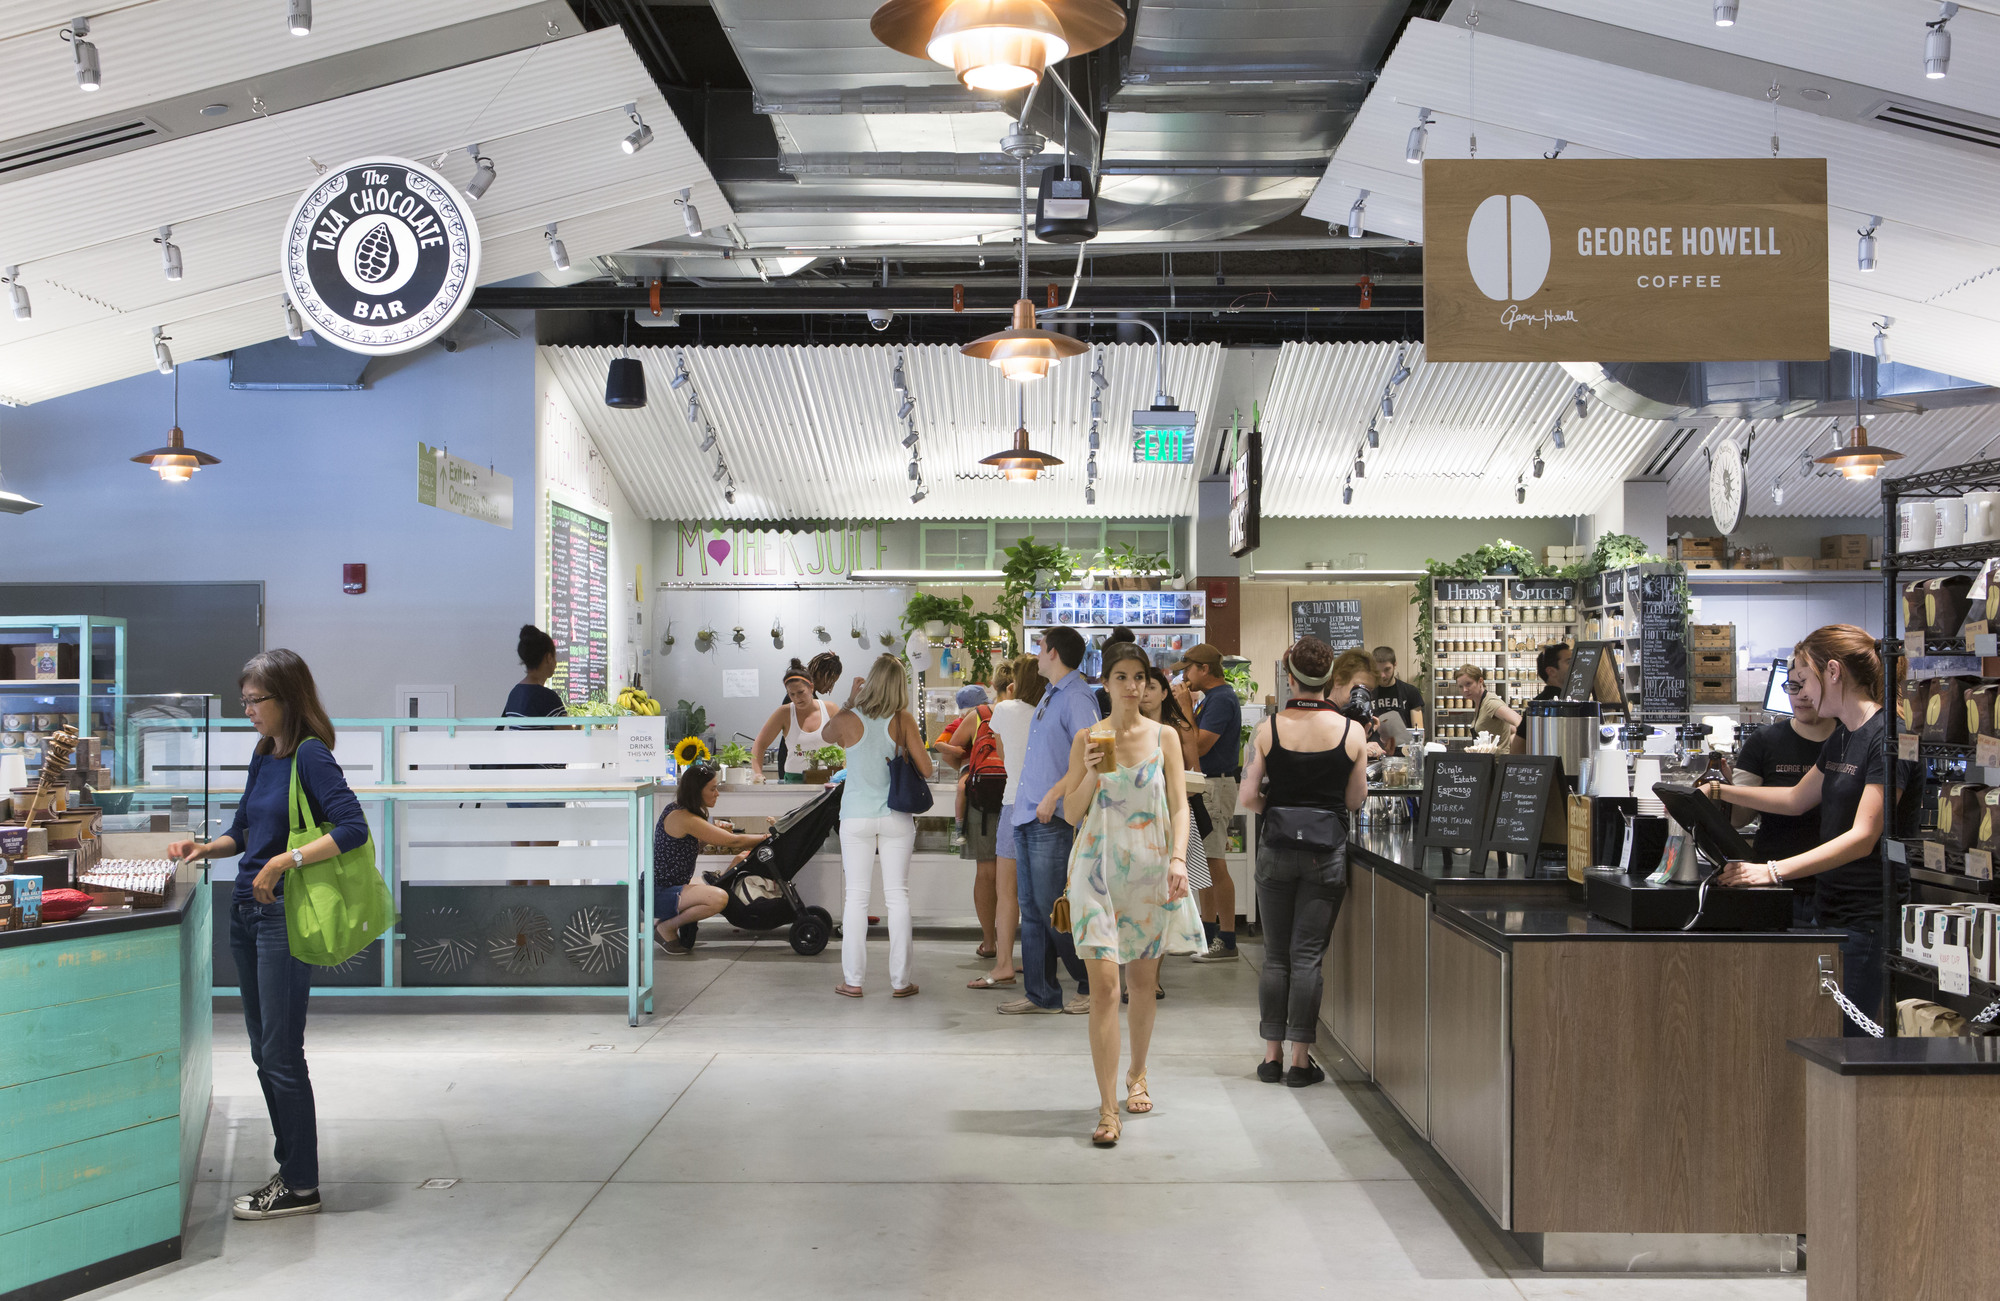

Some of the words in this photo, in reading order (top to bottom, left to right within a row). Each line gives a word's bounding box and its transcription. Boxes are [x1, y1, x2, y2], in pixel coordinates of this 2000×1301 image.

[362, 170, 389, 186] The
[312, 208, 350, 251] TAZA
[350, 188, 444, 250] CHOCOLATE
[1577, 227, 1673, 256] GEORGE
[1682, 226, 1782, 256] HOWELL
[1637, 275, 1721, 288] COFFEE
[353, 300, 407, 320] BAR
[1145, 430, 1186, 461] EXIT
[449, 461, 463, 482] Exit
[463, 467, 471, 487] to
[449, 485, 481, 514] Congress
[481, 495, 501, 519] Street
[1312, 602, 1336, 614] DAILY
[1336, 601, 1359, 613] MENU
[1644, 630, 1660, 640] HOT
[1661, 630, 1676, 640] TEA
[1297, 700, 1318, 708] Canon
[1436, 762, 1463, 779] Single
[1775, 764, 1801, 773] GEORGE
[1453, 775, 1478, 784] Estate
[1437, 785, 1472, 797] Espresso
[1502, 791, 1513, 800] HOT
[1450, 816, 1473, 825] ITALIAN
[1570, 806, 1588, 829] GEORGE
[1570, 827, 1588, 851] HOWELL
